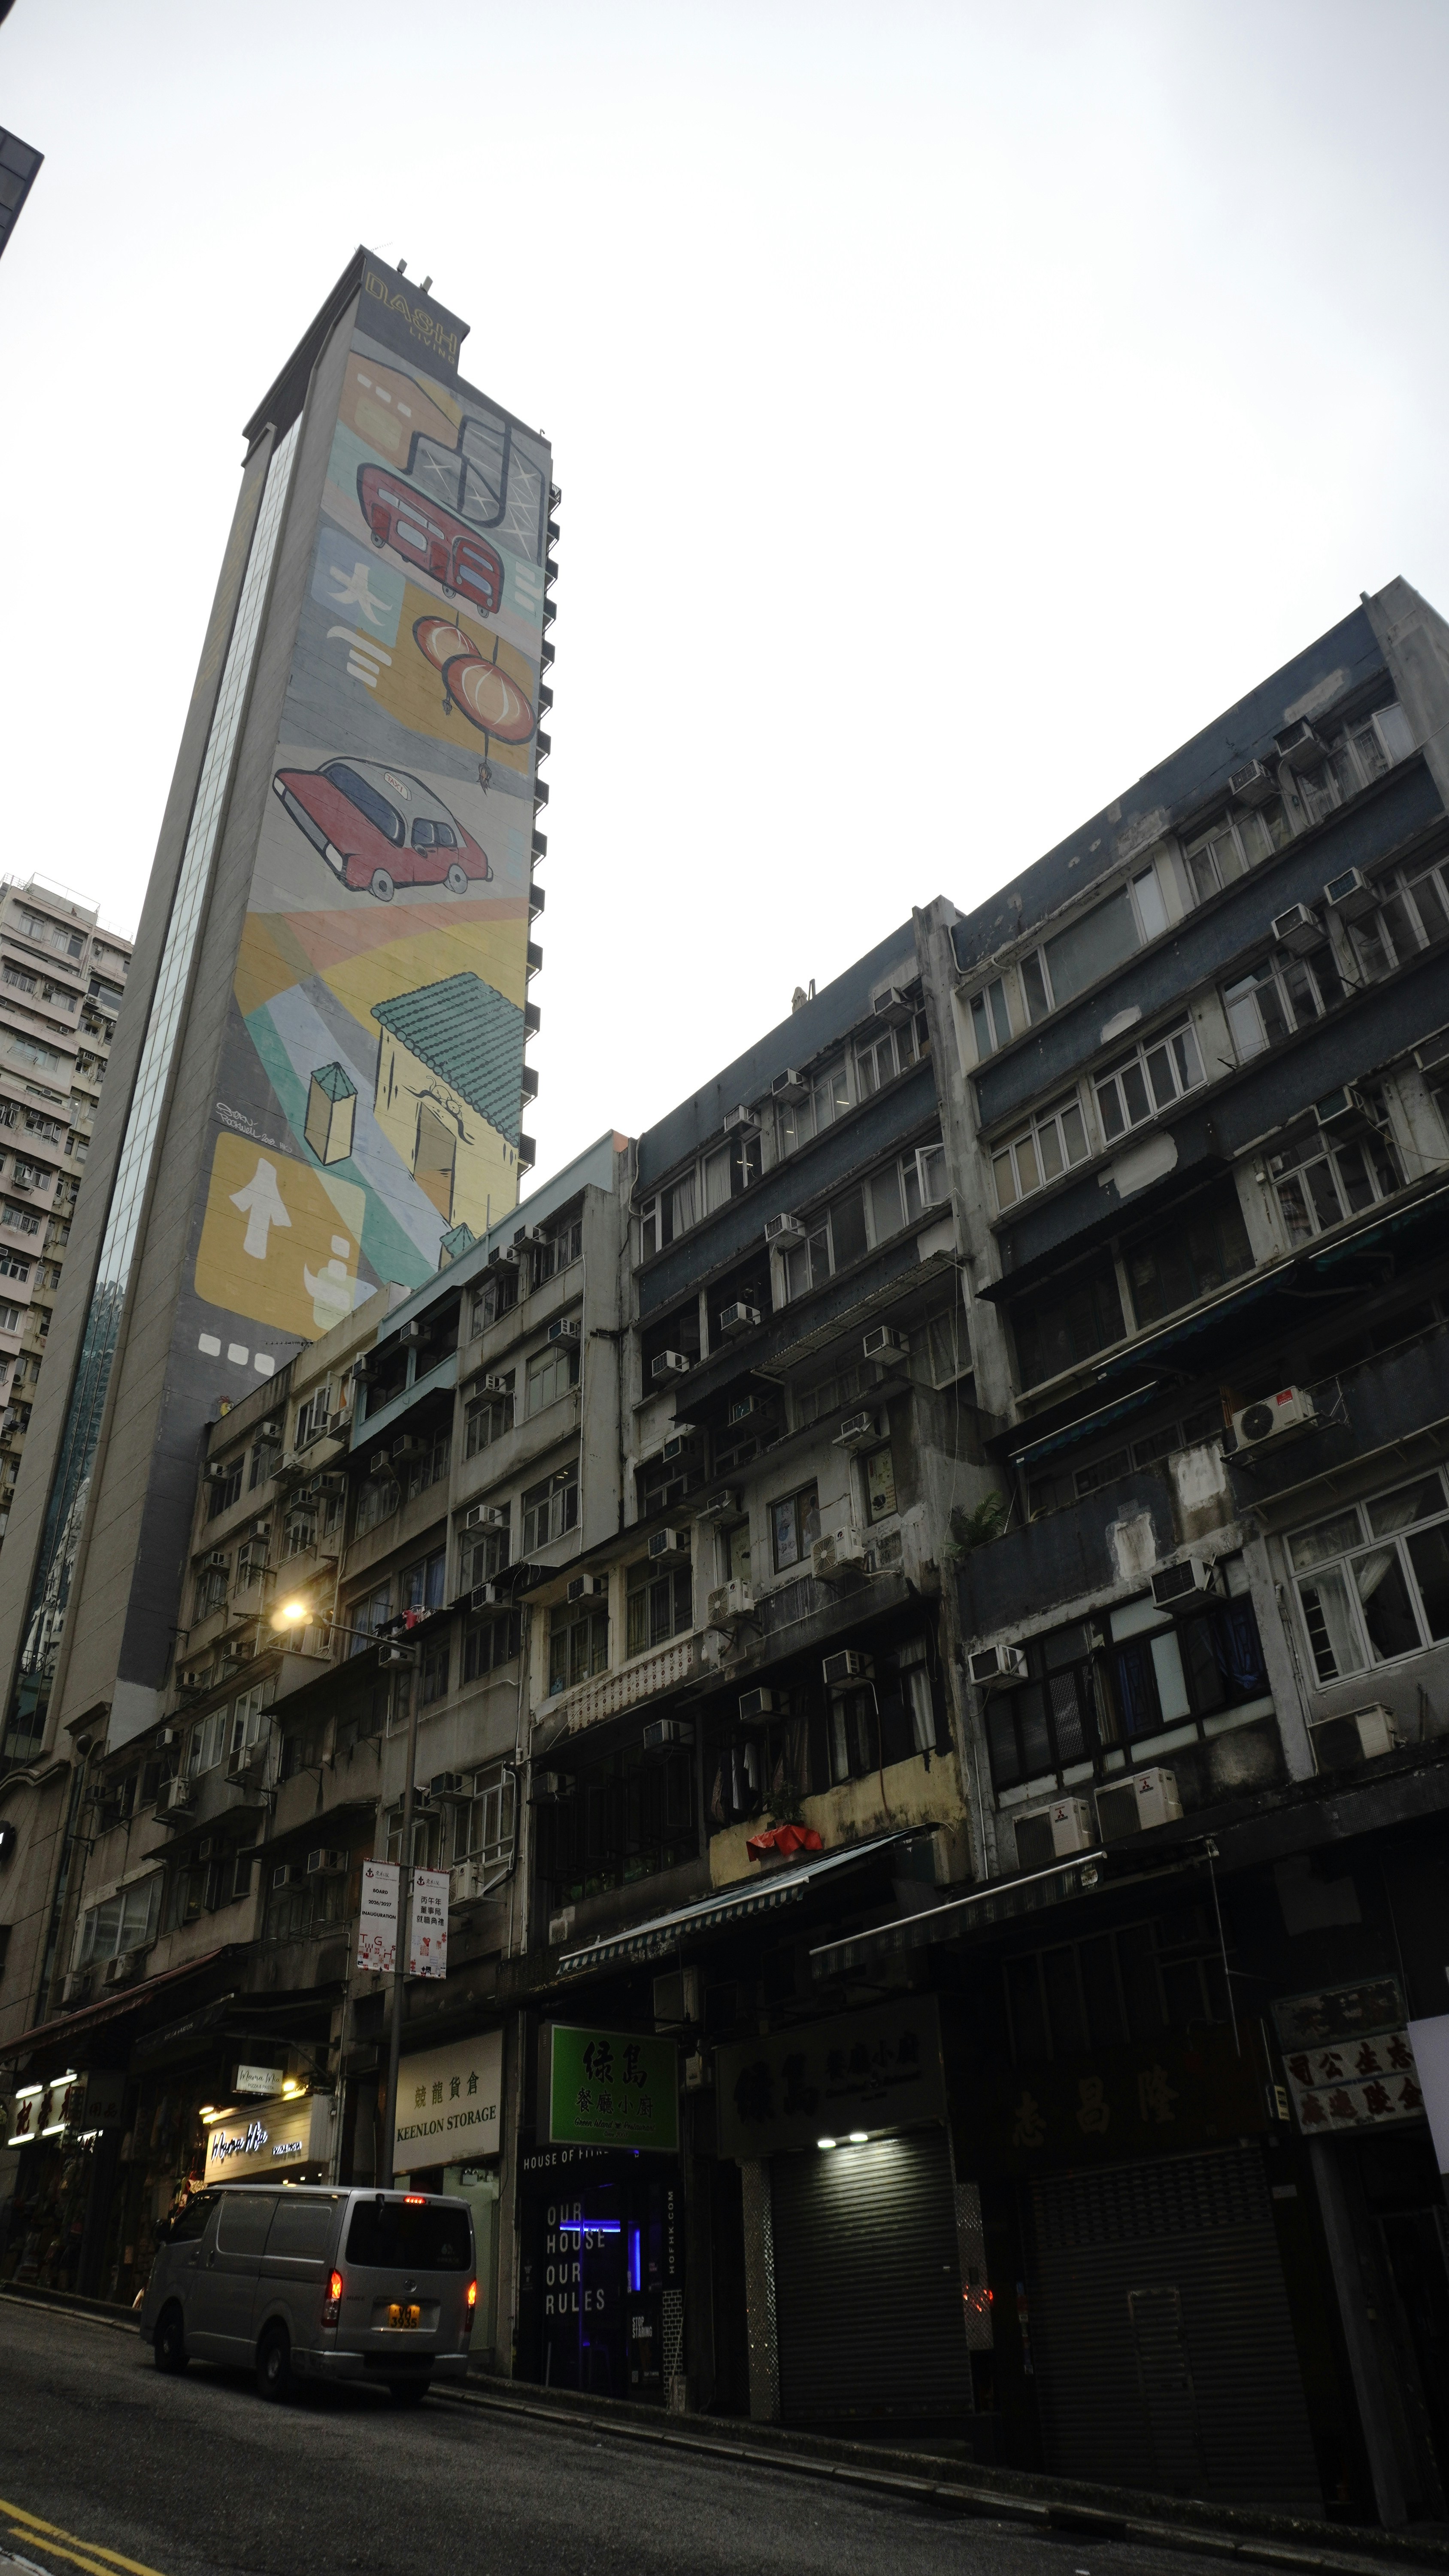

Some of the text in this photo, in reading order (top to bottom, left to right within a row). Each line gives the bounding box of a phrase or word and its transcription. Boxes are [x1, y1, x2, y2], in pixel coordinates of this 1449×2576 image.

[366, 271, 457, 355] DASH
[410, 326, 455, 364] LIVING
[387, 774, 403, 793] TAXI
[421, 1896, 441, 1905] 丙午年
[421, 1906, 441, 1915] 董事局
[362, 1911, 396, 1919] INAUGURATION
[417, 1915, 444, 1926] 就職典禮
[240, 2070, 281, 2085] Mama Mia
[414, 2071, 479, 2110] 競龍貨倉
[576, 2087, 653, 2119] 餐廳小廚
[397, 2105, 496, 2142] KEENLON STORAGE
[574, 2117, 655, 2132] Green Island Restaurant
[211, 2121, 268, 2162] Mama Mia
[524, 2153, 557, 2170] HOUSE
[562, 2149, 574, 2163] OF
[547, 2202, 581, 2227] OUR
[547, 2230, 605, 2254] HOUSE
[546, 2262, 581, 2287] OUR
[546, 2288, 605, 2315] RULES
[632, 2316, 644, 2327] STOP
[632, 2326, 653, 2339] STARING
